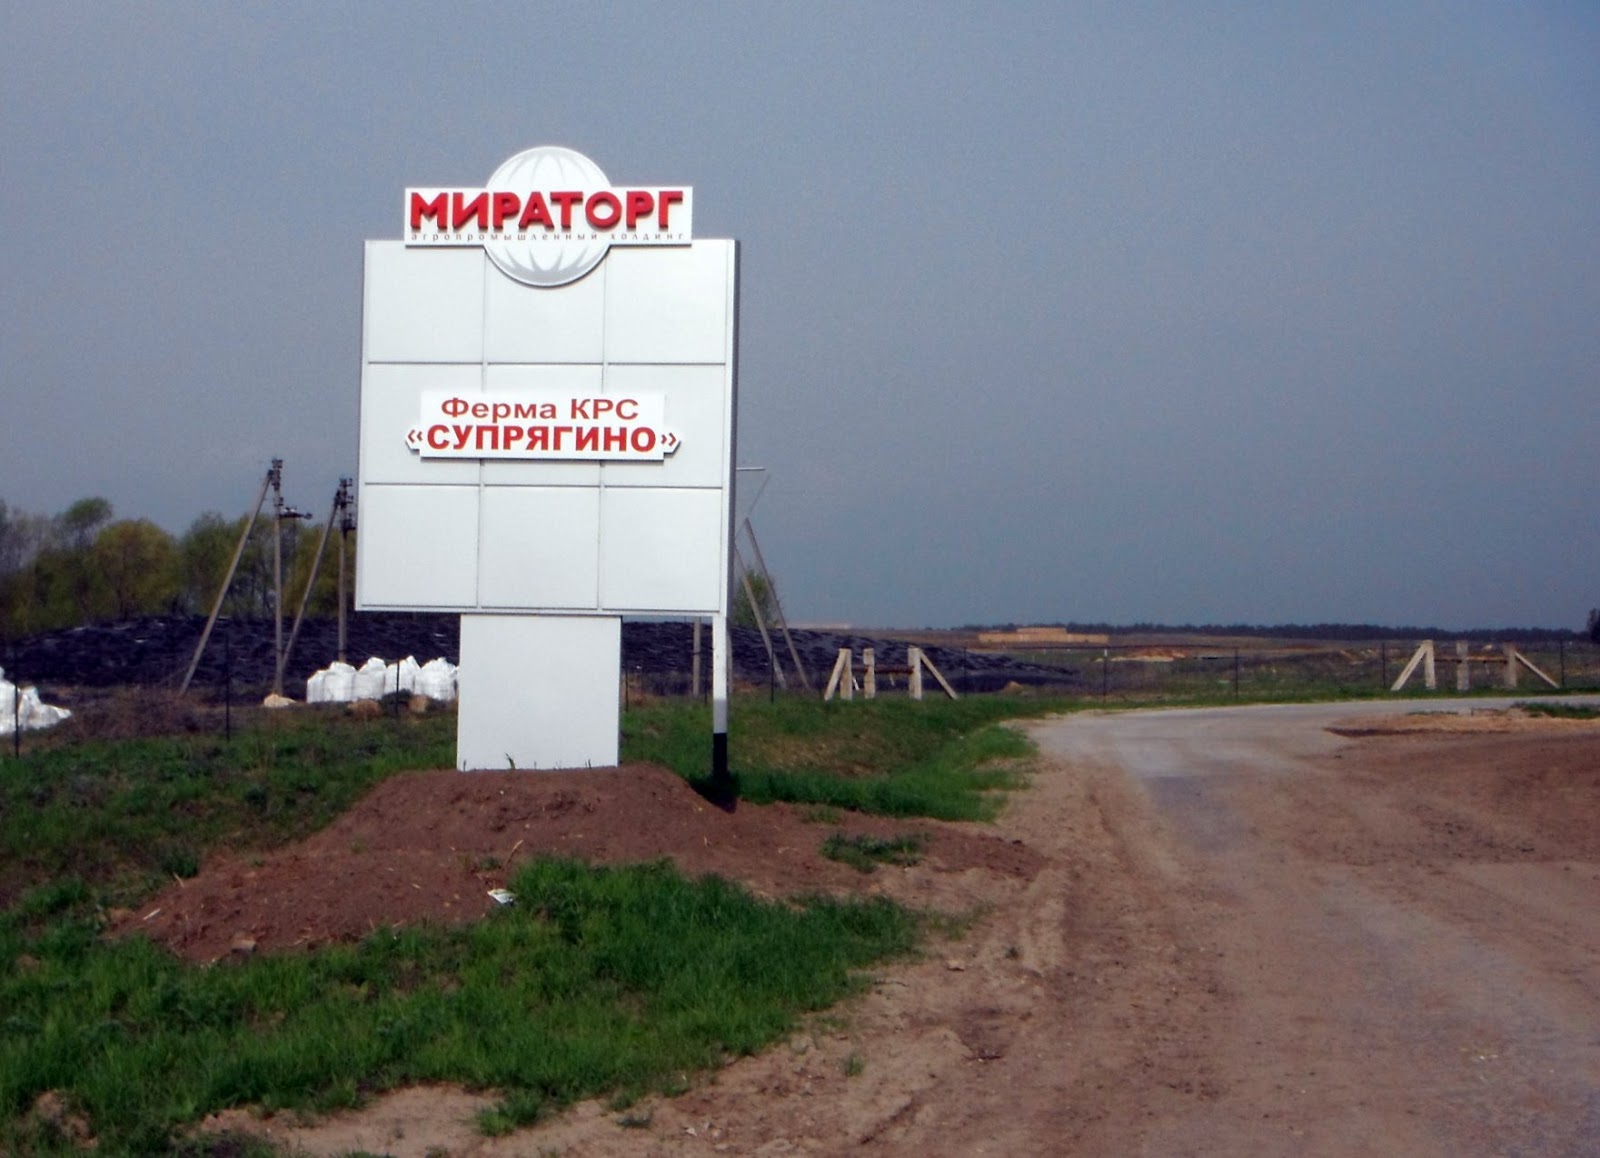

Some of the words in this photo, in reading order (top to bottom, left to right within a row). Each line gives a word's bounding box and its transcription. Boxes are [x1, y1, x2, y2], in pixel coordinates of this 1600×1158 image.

[410, 190, 684, 230] МИРАТОРГ
[441, 397, 557, 423] Ферма
[570, 398, 639, 420] КРС
[408, 424, 677, 453] «СУПРЯГИНО»
